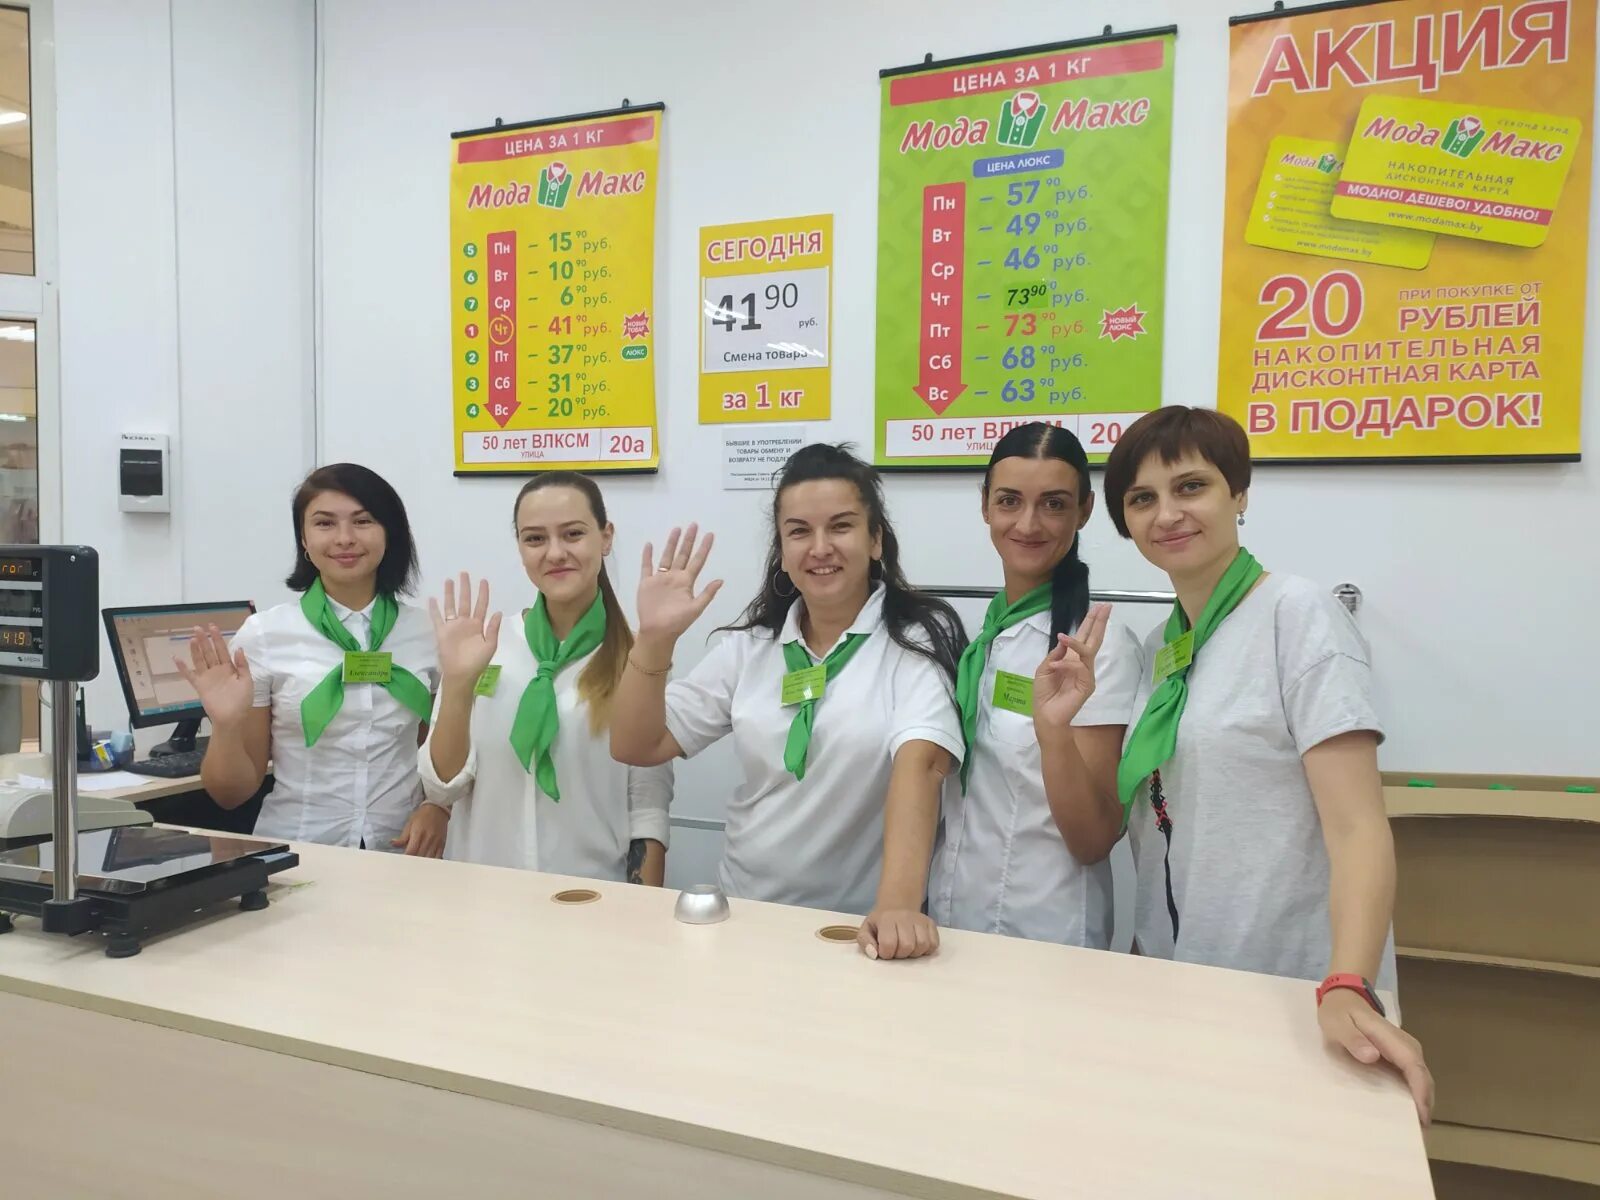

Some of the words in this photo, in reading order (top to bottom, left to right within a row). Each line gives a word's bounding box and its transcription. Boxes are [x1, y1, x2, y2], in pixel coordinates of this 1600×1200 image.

[1251, 0, 1571, 97] АКЦИЯ
[953, 70, 1006, 94] ЦЕНА
[1014, 66, 1040, 84] ЗА
[1048, 63, 1057, 78] 1
[1066, 58, 1093, 76] КГ
[900, 116, 989, 154] Мода
[1051, 97, 1150, 133] Макс
[505, 136, 544, 155] ЦЕНА
[548, 136, 568, 152] ЗА
[572, 133, 579, 147] 1
[586, 130, 605, 146] КГ
[1362, 115, 1441, 148] Мода
[1481, 130, 1566, 163] Макс
[987, 161, 1015, 173] ЦЕНА
[1017, 155, 1051, 169] ЛЮКС
[1388, 160, 1515, 186] НАКОПИТЕЛЬНАЯ
[467, 182, 532, 210] Мода
[576, 170, 646, 198] Макс
[1385, 172, 1465, 190] ДИСКОНТНАЯ
[1472, 185, 1510, 196] КАРТА
[933, 196, 955, 211] Пн
[1347, 184, 1404, 202] МОДНО!
[1406, 192, 1470, 212] ДЕШЕВО!
[1472, 203, 1540, 221] УДОБНО!
[1388, 211, 1483, 233] www.modamax.by
[932, 228, 952, 243] Вт
[494, 242, 511, 255] Пн
[707, 231, 822, 263] СЕГОДНЯ
[494, 270, 508, 282] Вт
[931, 263, 954, 280] Ср
[930, 292, 950, 307] Чт
[1399, 289, 1430, 301] ПРИ
[1437, 284, 1514, 300] ПОКУПКЕ
[1520, 281, 1543, 296] ОТ
[494, 297, 511, 311] Ср
[1256, 270, 1364, 341] 20
[1109, 315, 1137, 324] НОВЫЙ
[1399, 297, 1541, 333] РУБЛЕЙ
[494, 324, 508, 336] Чт
[930, 324, 950, 338] Пт
[1109, 323, 1132, 331] ЛЮКС
[494, 351, 509, 363] Пт
[723, 351, 762, 362] Смена
[1253, 334, 1541, 368] НАКОПИТЕЛЬНАЯ
[929, 355, 952, 370] Сб
[494, 376, 510, 390] Сб
[1251, 362, 1440, 394] ДИСКОНТНАЯ
[1448, 359, 1541, 383] КАРТА
[724, 392, 747, 409] за
[756, 383, 771, 408] 1
[780, 389, 804, 407] кг
[929, 387, 949, 401] Вс
[494, 404, 509, 416] Вс
[1249, 402, 1277, 435] В
[1290, 393, 1543, 439] ПОДАРОК!
[911, 424, 934, 441] 50
[940, 425, 976, 441] лет
[482, 435, 498, 450] 50
[503, 437, 528, 450] лет
[532, 433, 590, 449] ВЛКСМ
[609, 435, 645, 454] 20а
[966, 442, 998, 452] УЛИЦ
